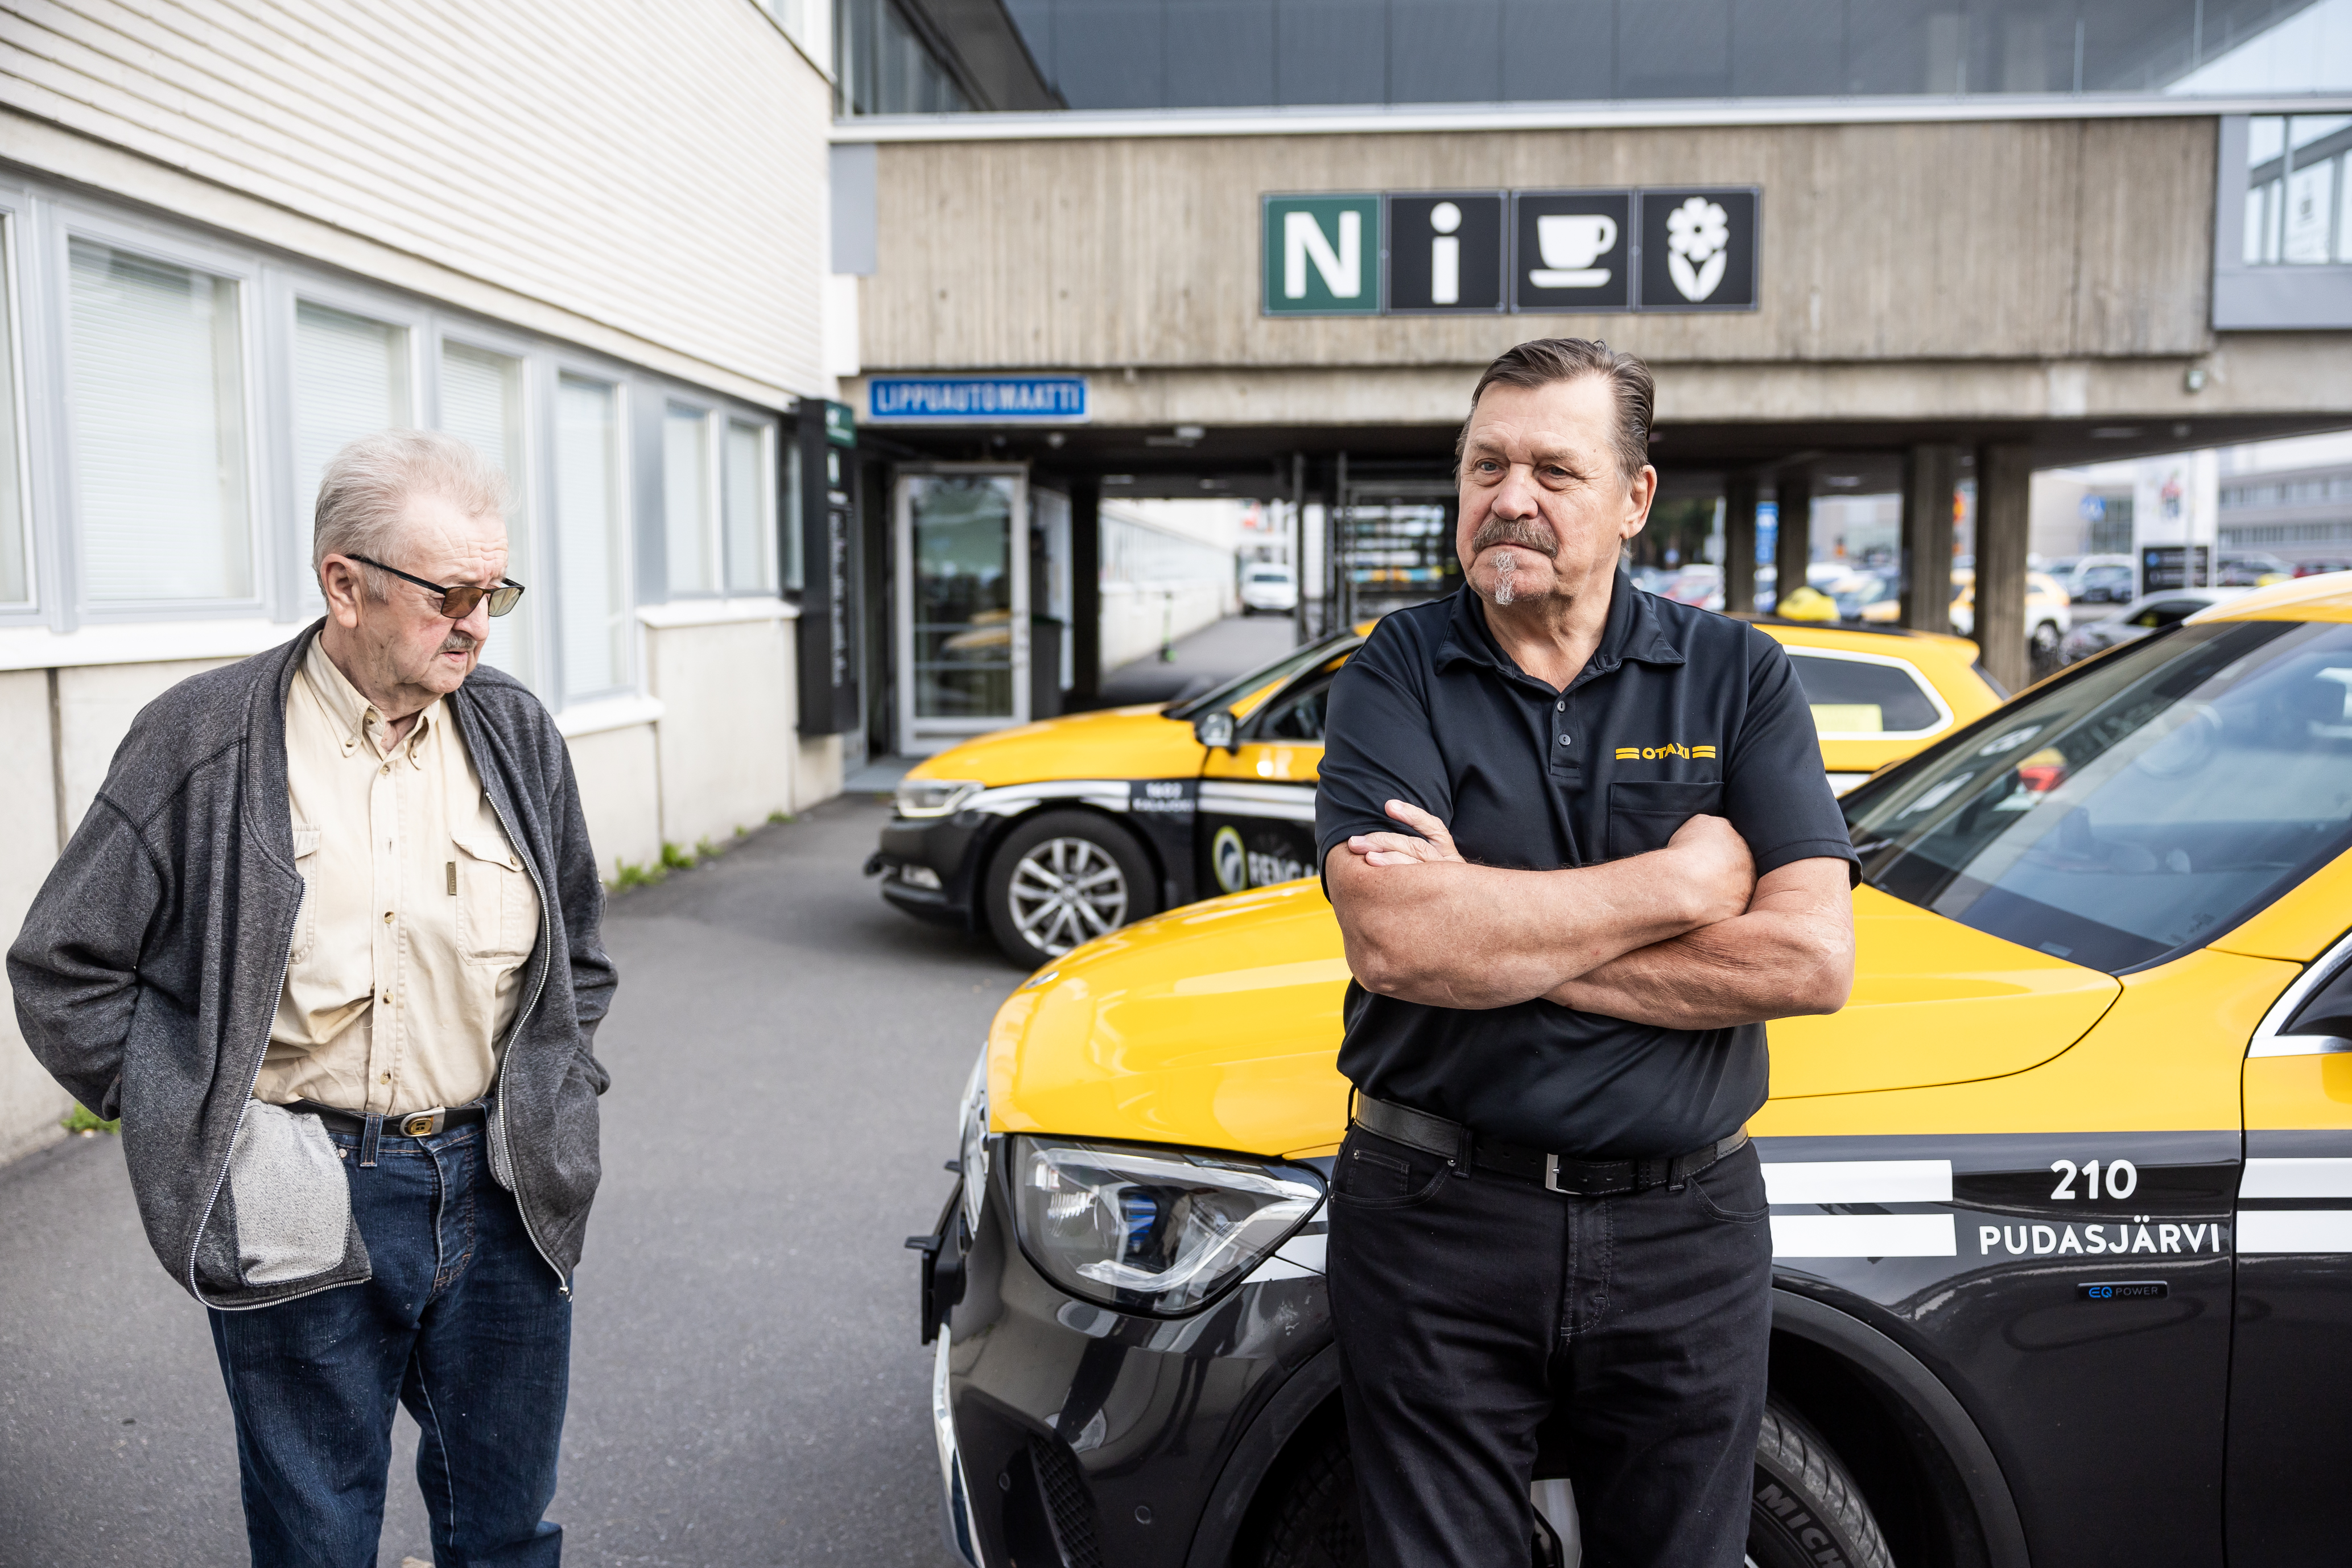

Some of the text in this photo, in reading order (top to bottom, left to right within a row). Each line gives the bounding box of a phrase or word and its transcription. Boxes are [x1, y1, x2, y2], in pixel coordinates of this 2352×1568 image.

[1284, 211, 1361, 299] N
[1642, 742, 1690, 760] OTAXI
[2050, 1159, 2138, 1200] 210
[1979, 1215, 2220, 1255] PUDASJÄRVI
[2089, 1286, 2159, 1298] EQ POWER
